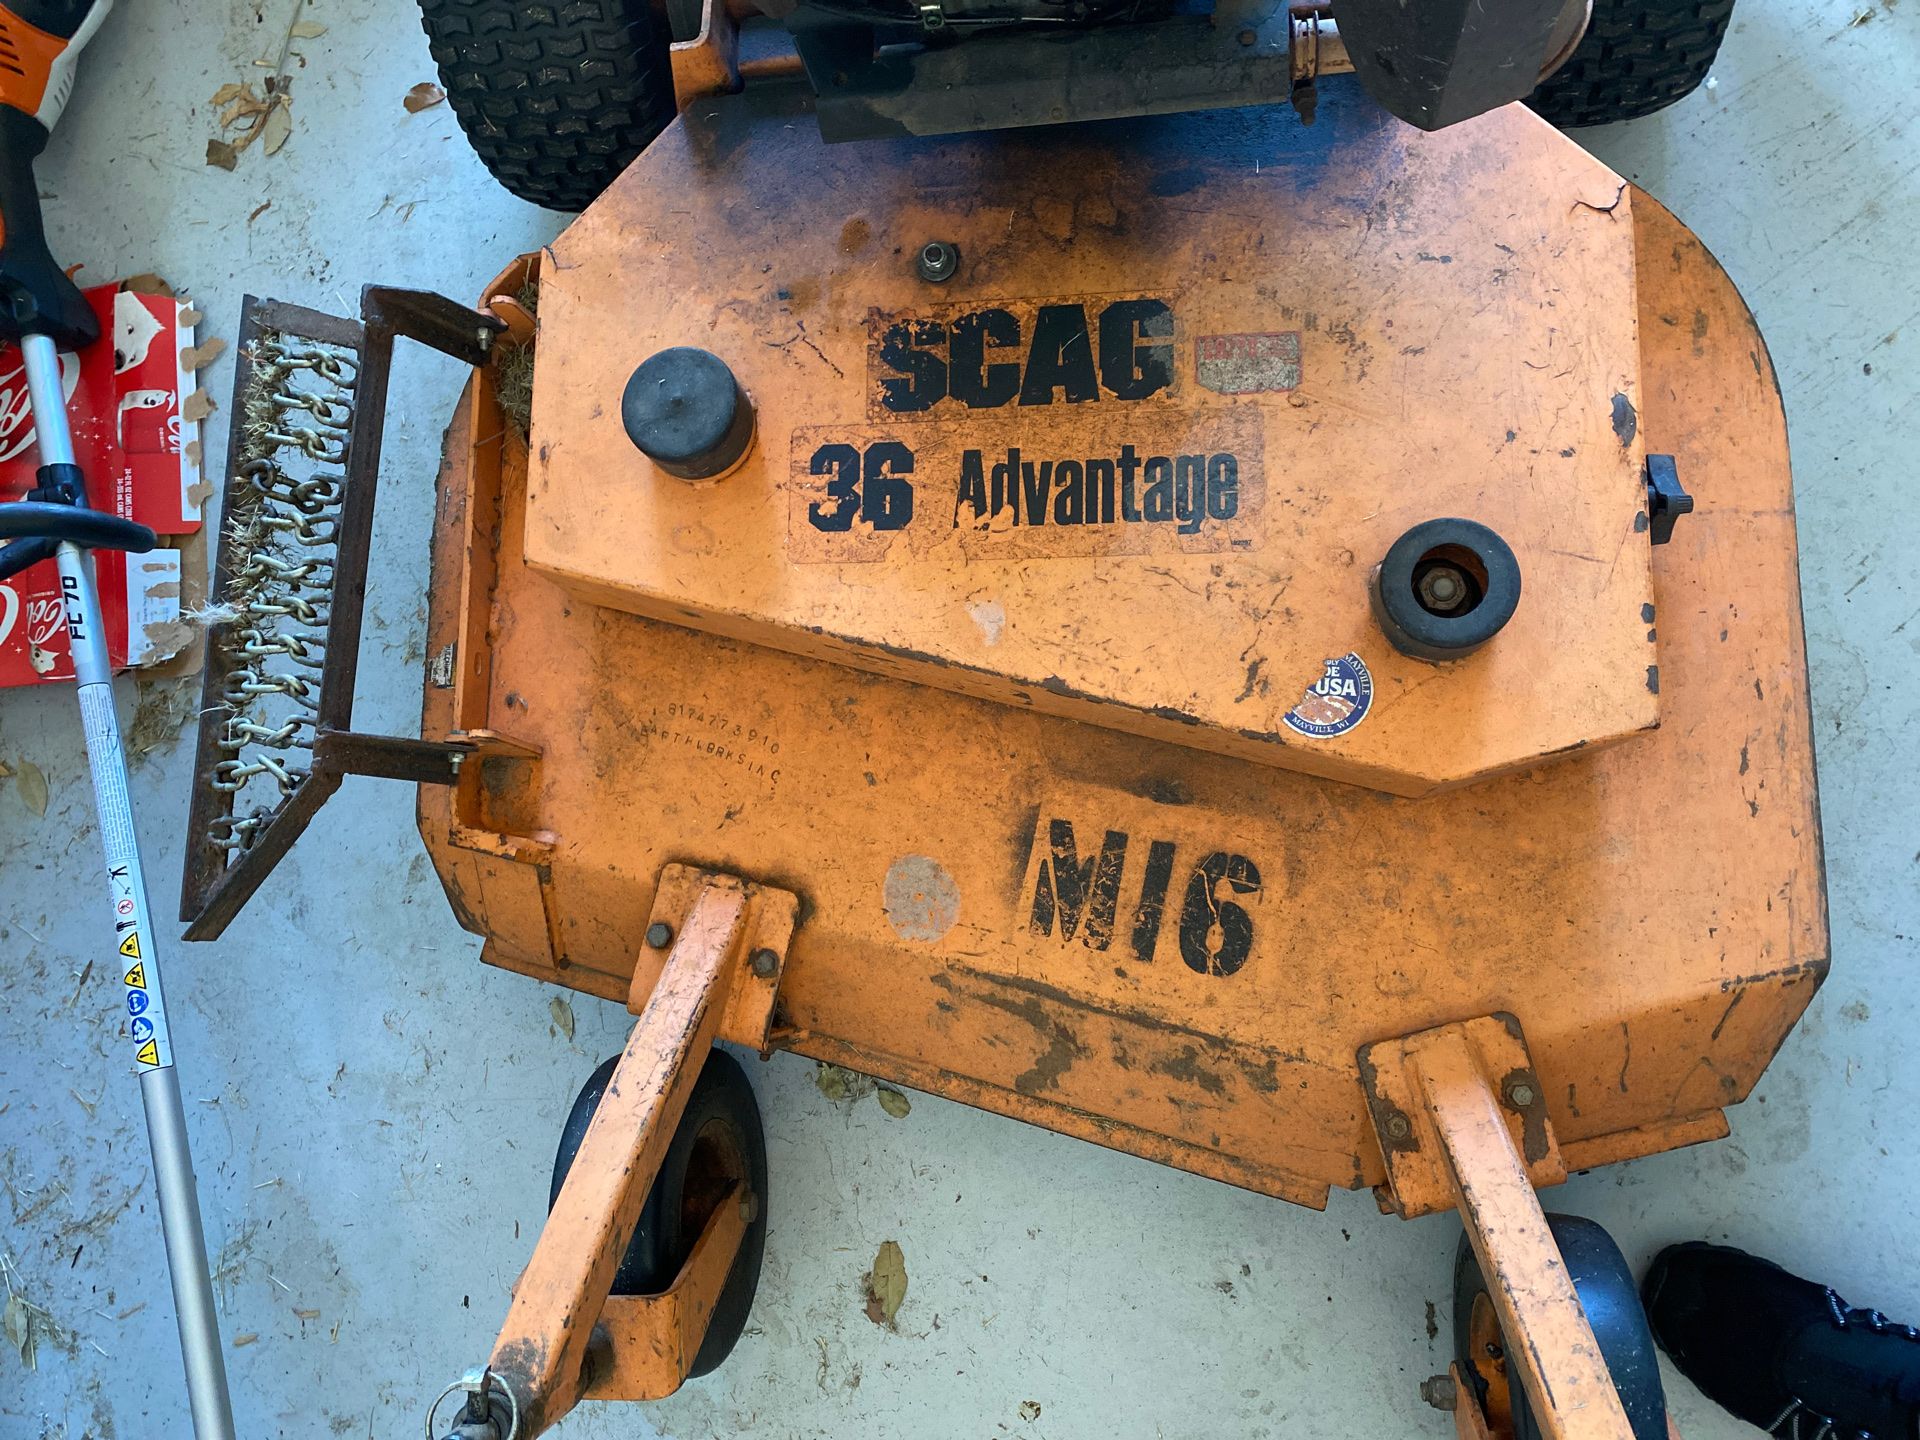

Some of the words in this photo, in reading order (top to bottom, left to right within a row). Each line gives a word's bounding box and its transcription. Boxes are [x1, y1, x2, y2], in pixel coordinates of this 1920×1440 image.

[879, 299, 1175, 413] SCAG
[808, 441, 915, 532] 36
[953, 444, 1239, 534] Advantage
[61, 575, 80, 605] 70
[66, 612, 86, 640] FC
[1315, 678, 1357, 697] USA
[1345, 654, 1370, 696] MAYVILLE
